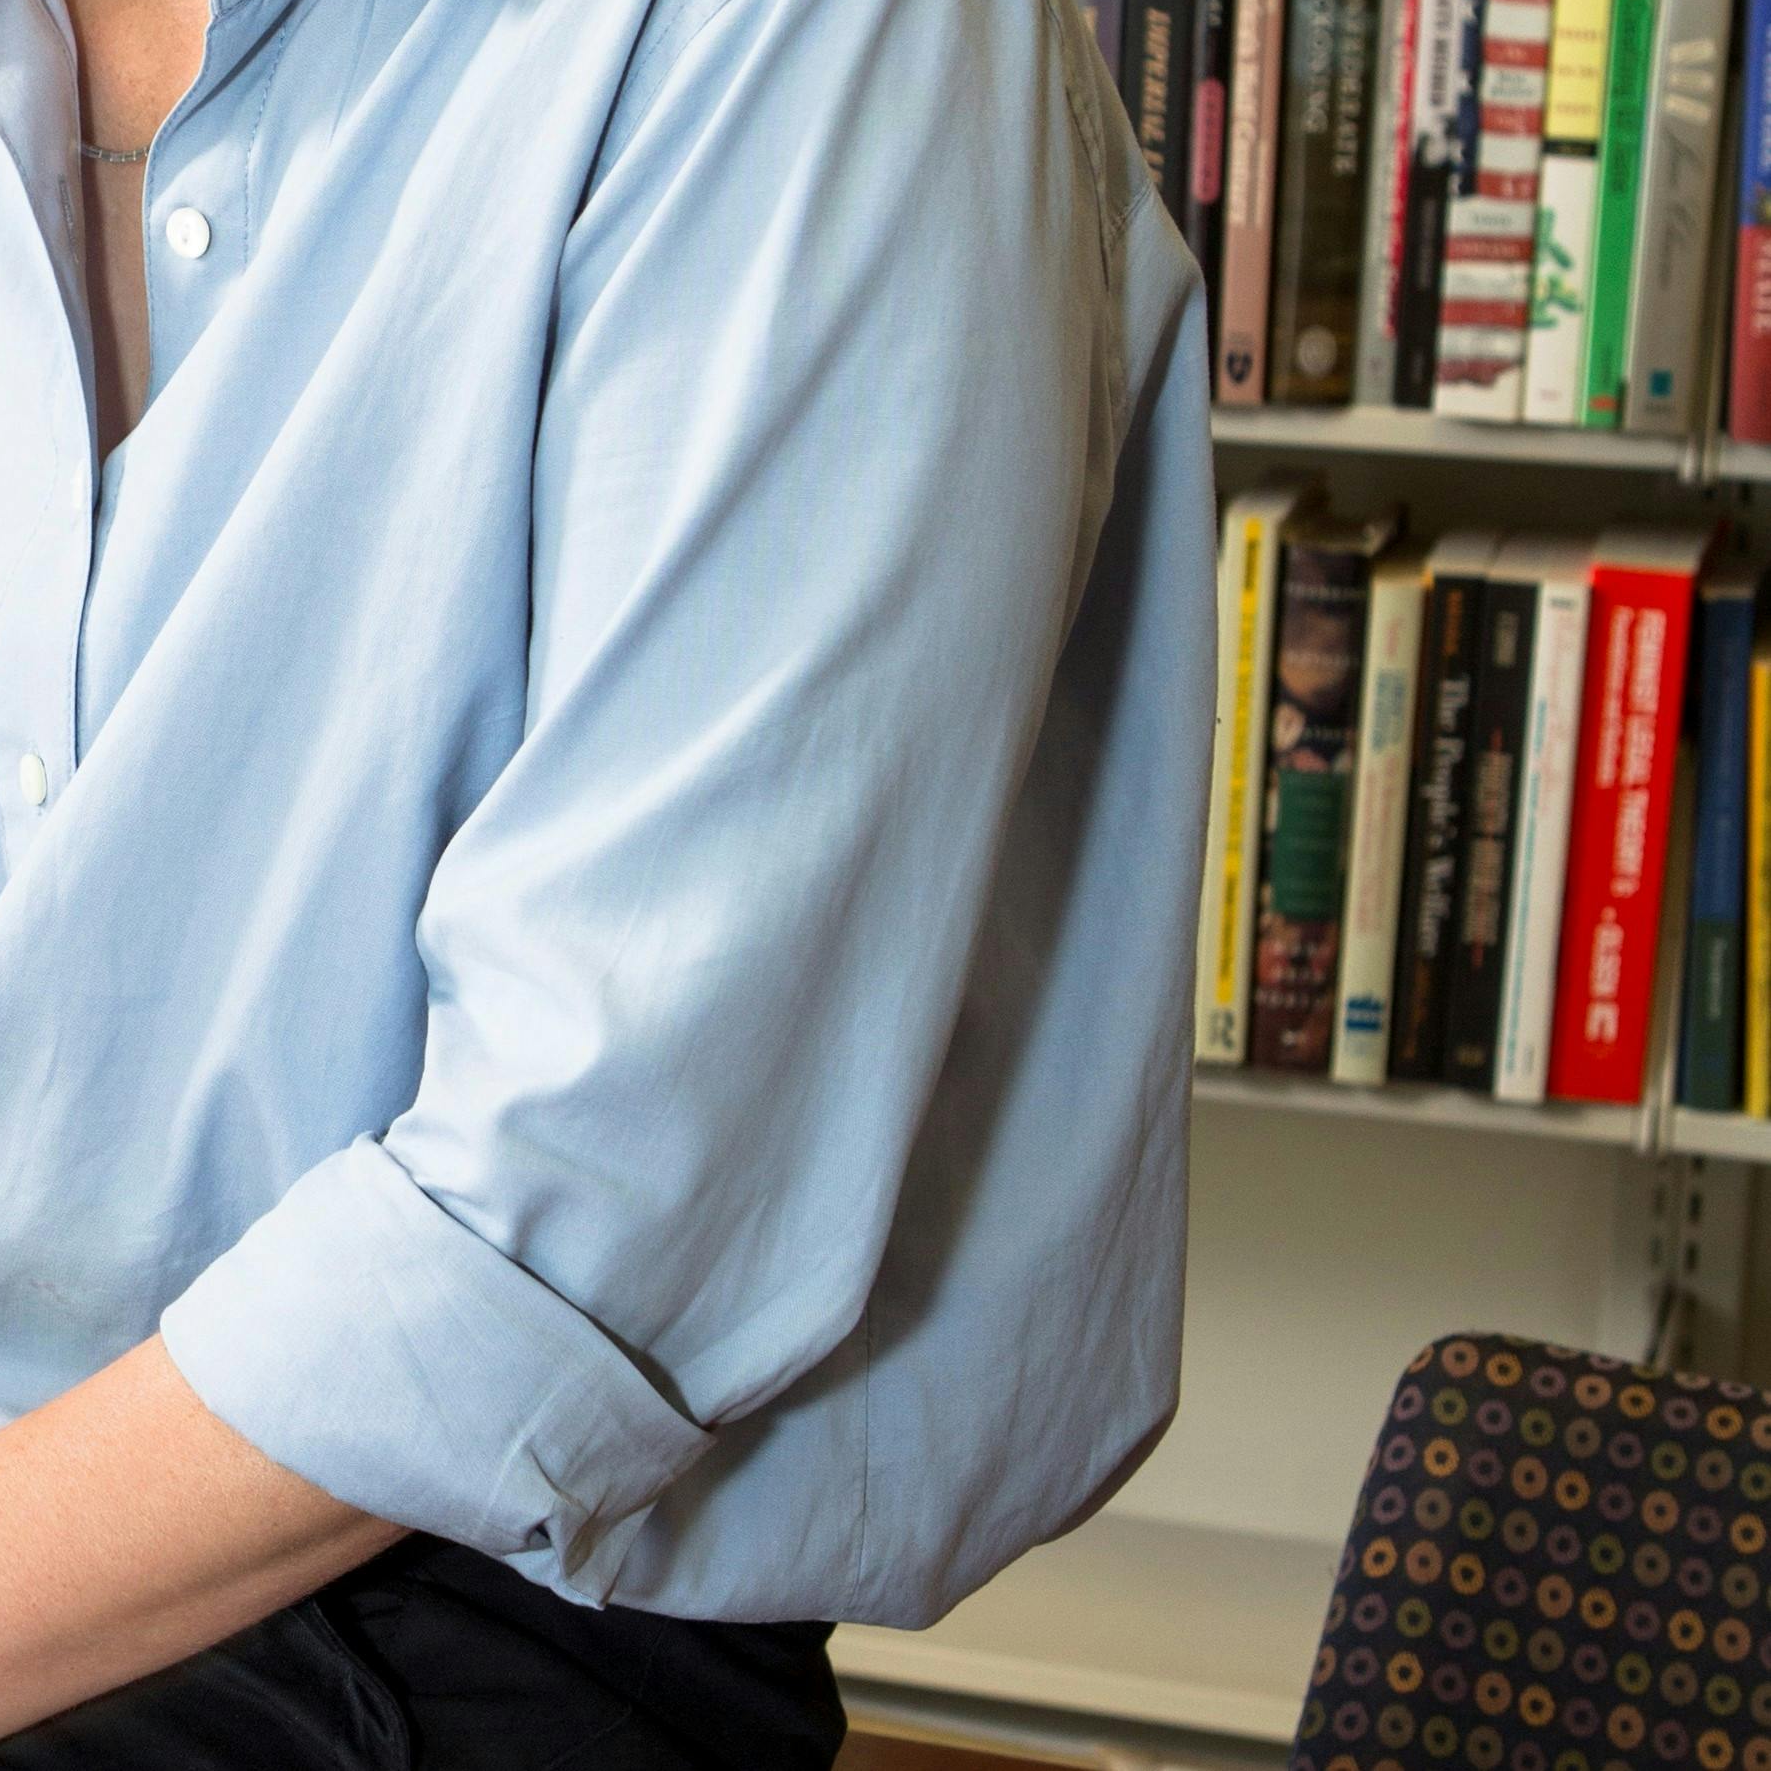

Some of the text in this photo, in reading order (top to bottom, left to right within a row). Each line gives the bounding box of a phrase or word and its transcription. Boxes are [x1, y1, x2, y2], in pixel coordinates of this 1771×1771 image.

[1141, 7, 1171, 146] IMPERIAL
[1438, 678, 1469, 731] The
[1614, 608, 1665, 876] FEMINIST LEGAL THEORY
[1421, 736, 1465, 848] People's
[1418, 855, 1453, 959] Welfare
[1593, 923, 1624, 997] OLSEN
